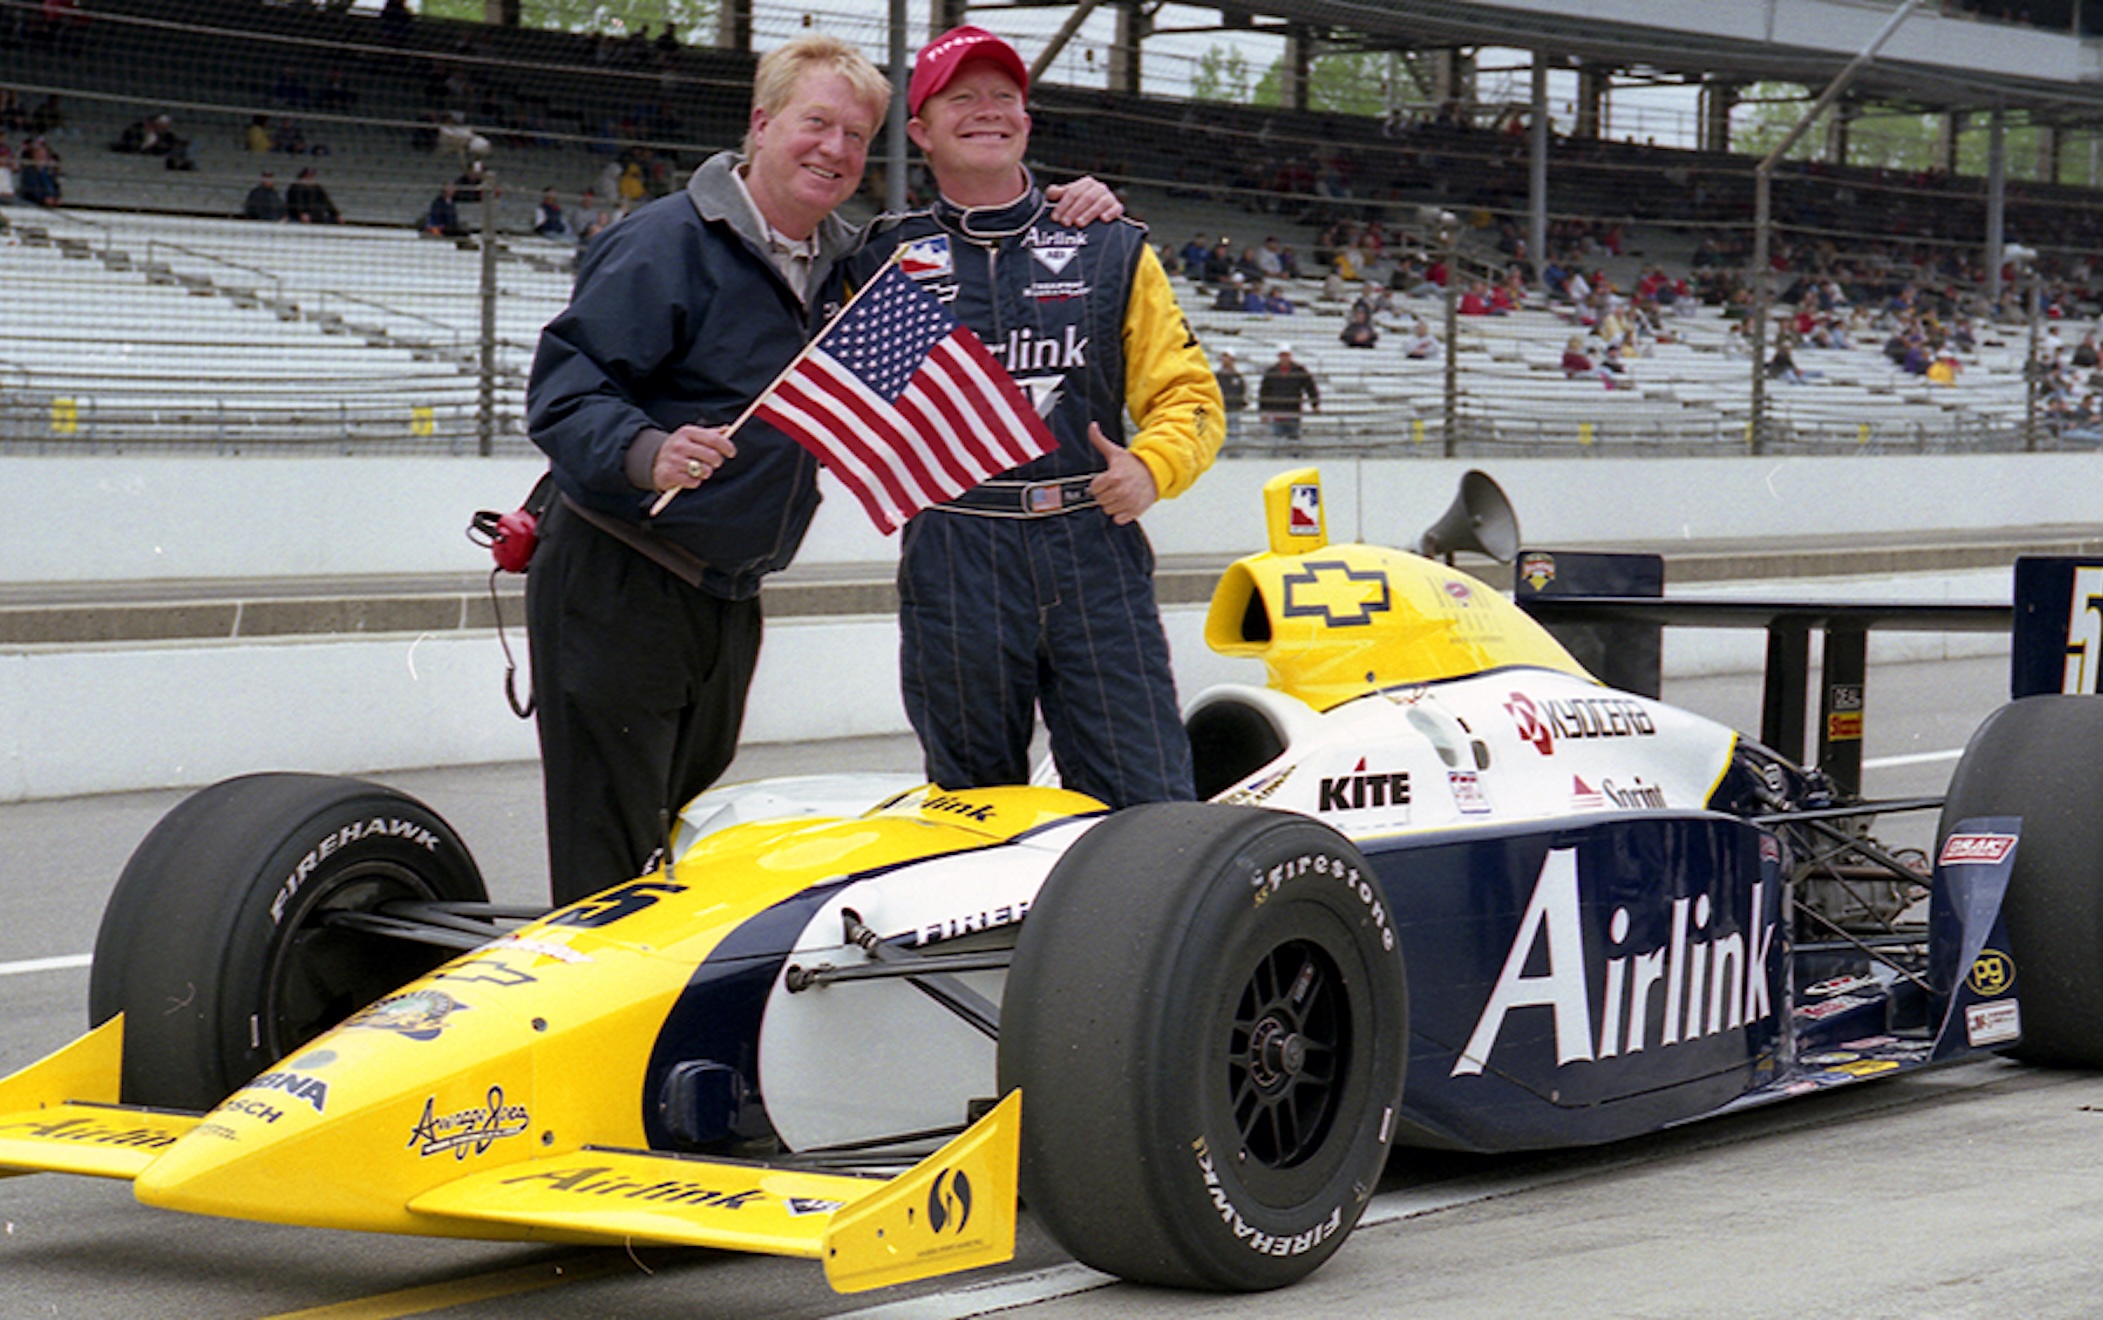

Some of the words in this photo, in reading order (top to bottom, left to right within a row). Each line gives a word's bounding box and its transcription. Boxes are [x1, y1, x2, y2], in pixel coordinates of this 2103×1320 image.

[1020, 226, 1088, 246] Airlink
[1538, 699, 1656, 739] KYOCERA
[1319, 771, 1411, 812] KITE
[1602, 775, 1667, 808] Sprint
[269, 816, 441, 926] FIREHAWK
[1267, 854, 1394, 952] Firestone
[1450, 846, 1776, 1079] Airlink
[0, 1118, 178, 1148] Airlin
[501, 1167, 768, 1210] Airlink
[1195, 1153, 1343, 1257] FIREHAWK
